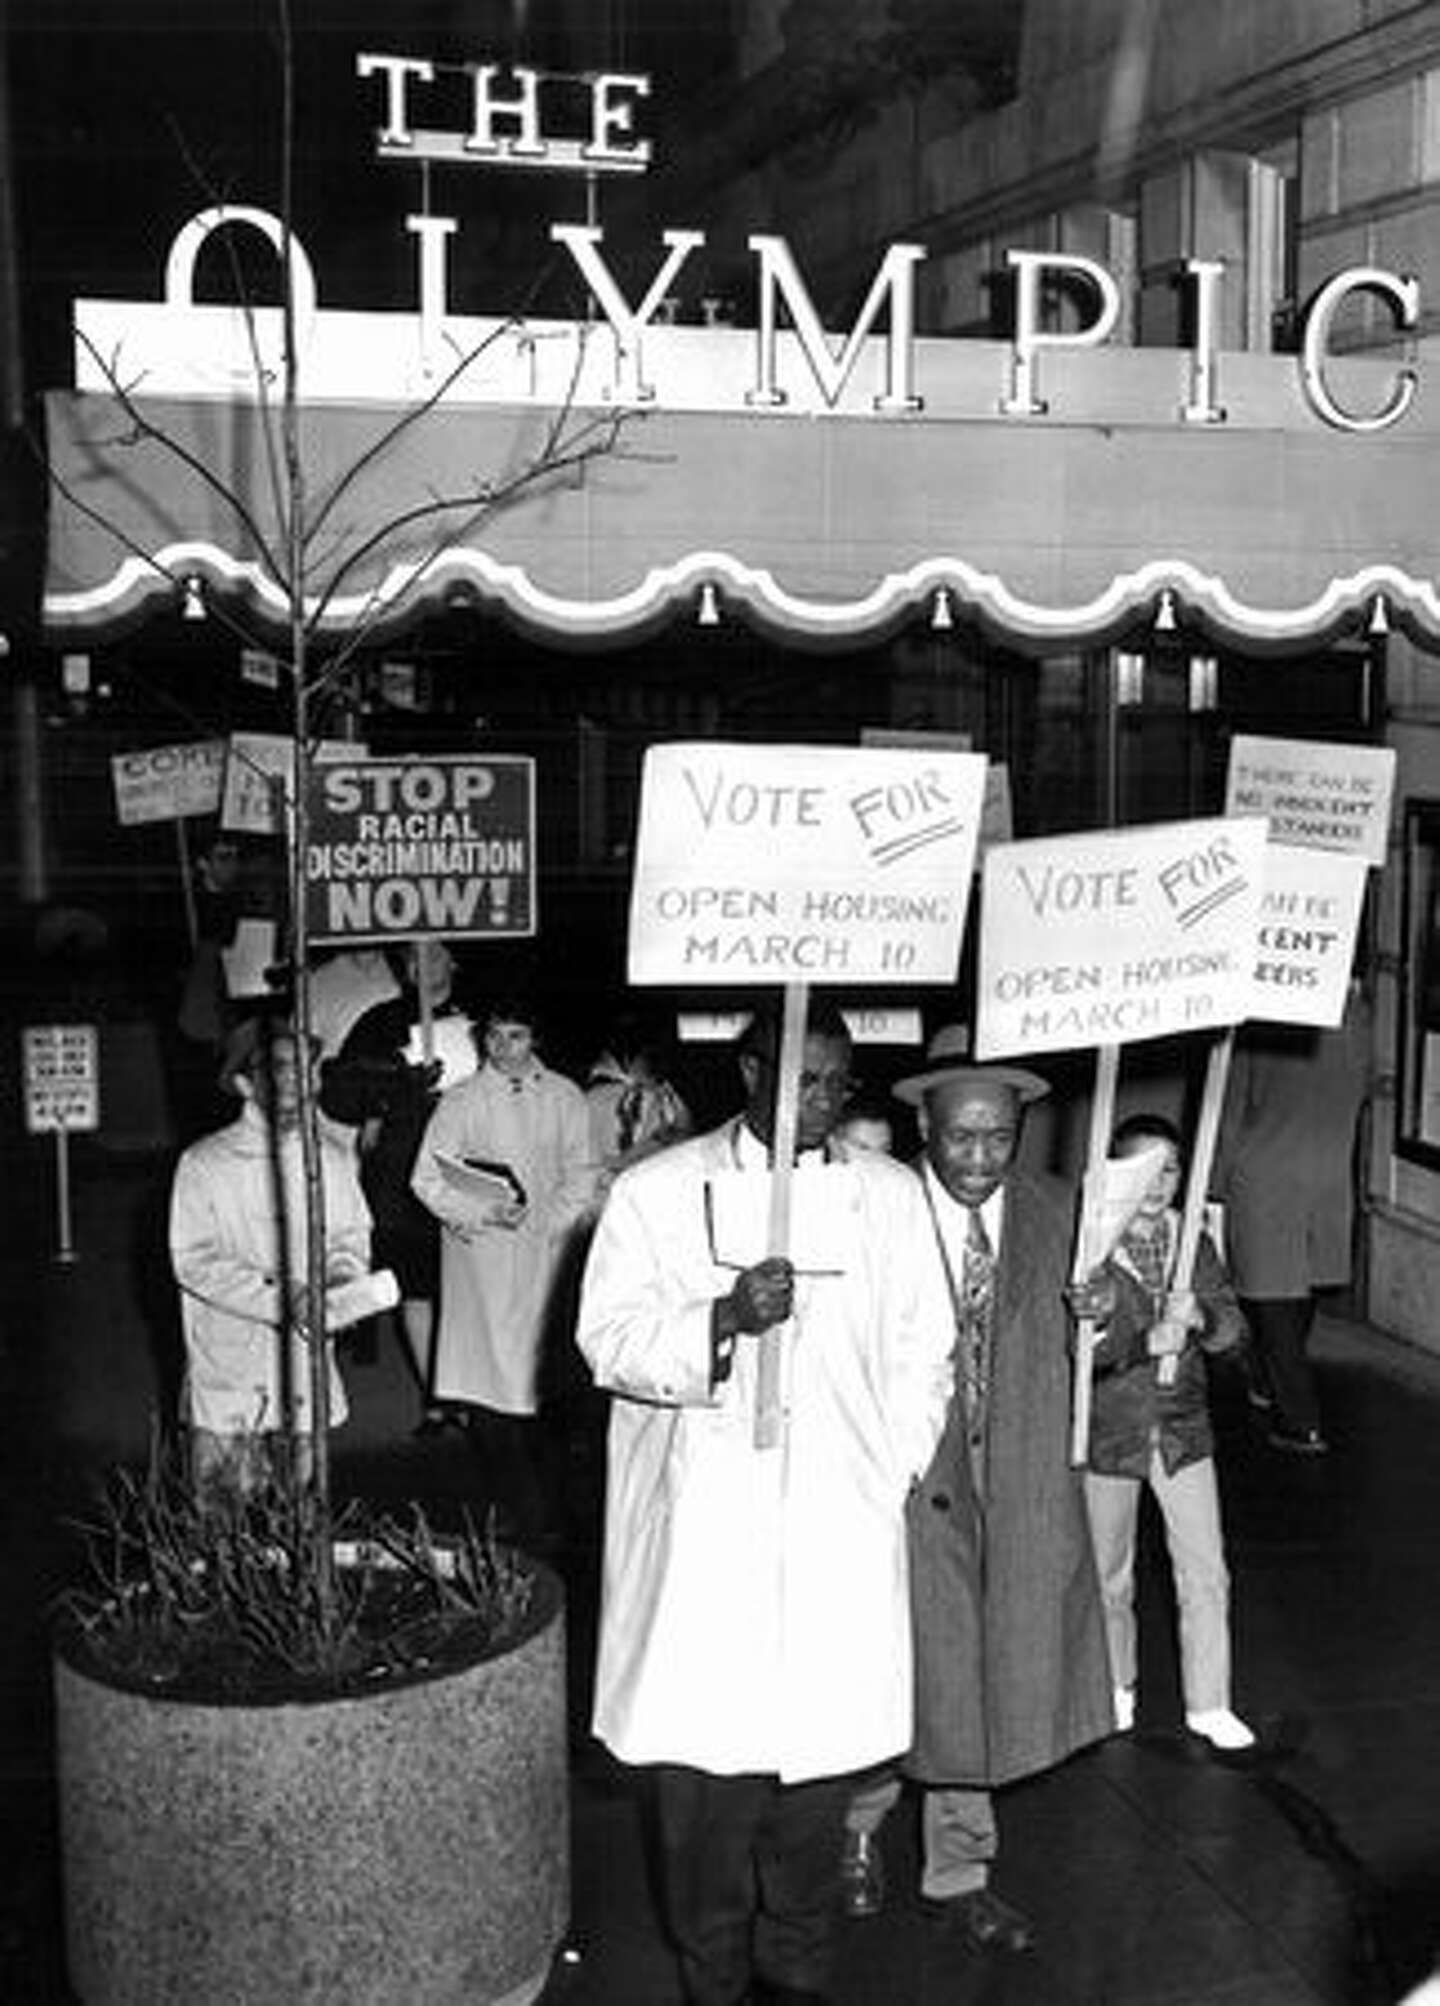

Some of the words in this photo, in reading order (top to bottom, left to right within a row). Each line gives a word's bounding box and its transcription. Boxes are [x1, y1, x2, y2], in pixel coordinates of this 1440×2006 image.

[358, 54, 651, 160] THE
[164, 204, 1420, 432] OLYMPIC
[325, 765, 495, 812] STOP
[683, 768, 827, 829] VOTE
[850, 770, 951, 838] FOR
[359, 814, 480, 841] RACIAL
[307, 840, 523, 879] DISCRIMINATION
[1016, 864, 1139, 917] VOTE
[1158, 836, 1238, 907] FOR
[329, 877, 510, 931] NOW!
[658, 887, 778, 919] OPEN
[801, 891, 950, 924] HOUSING
[684, 934, 850, 968] MARCH
[880, 942, 916, 971] 10
[1258, 926, 1338, 955] CENT
[995, 965, 1103, 1002] OPEN
[1020, 998, 1161, 1036] MARCH
[1184, 994, 1214, 1020] 10
